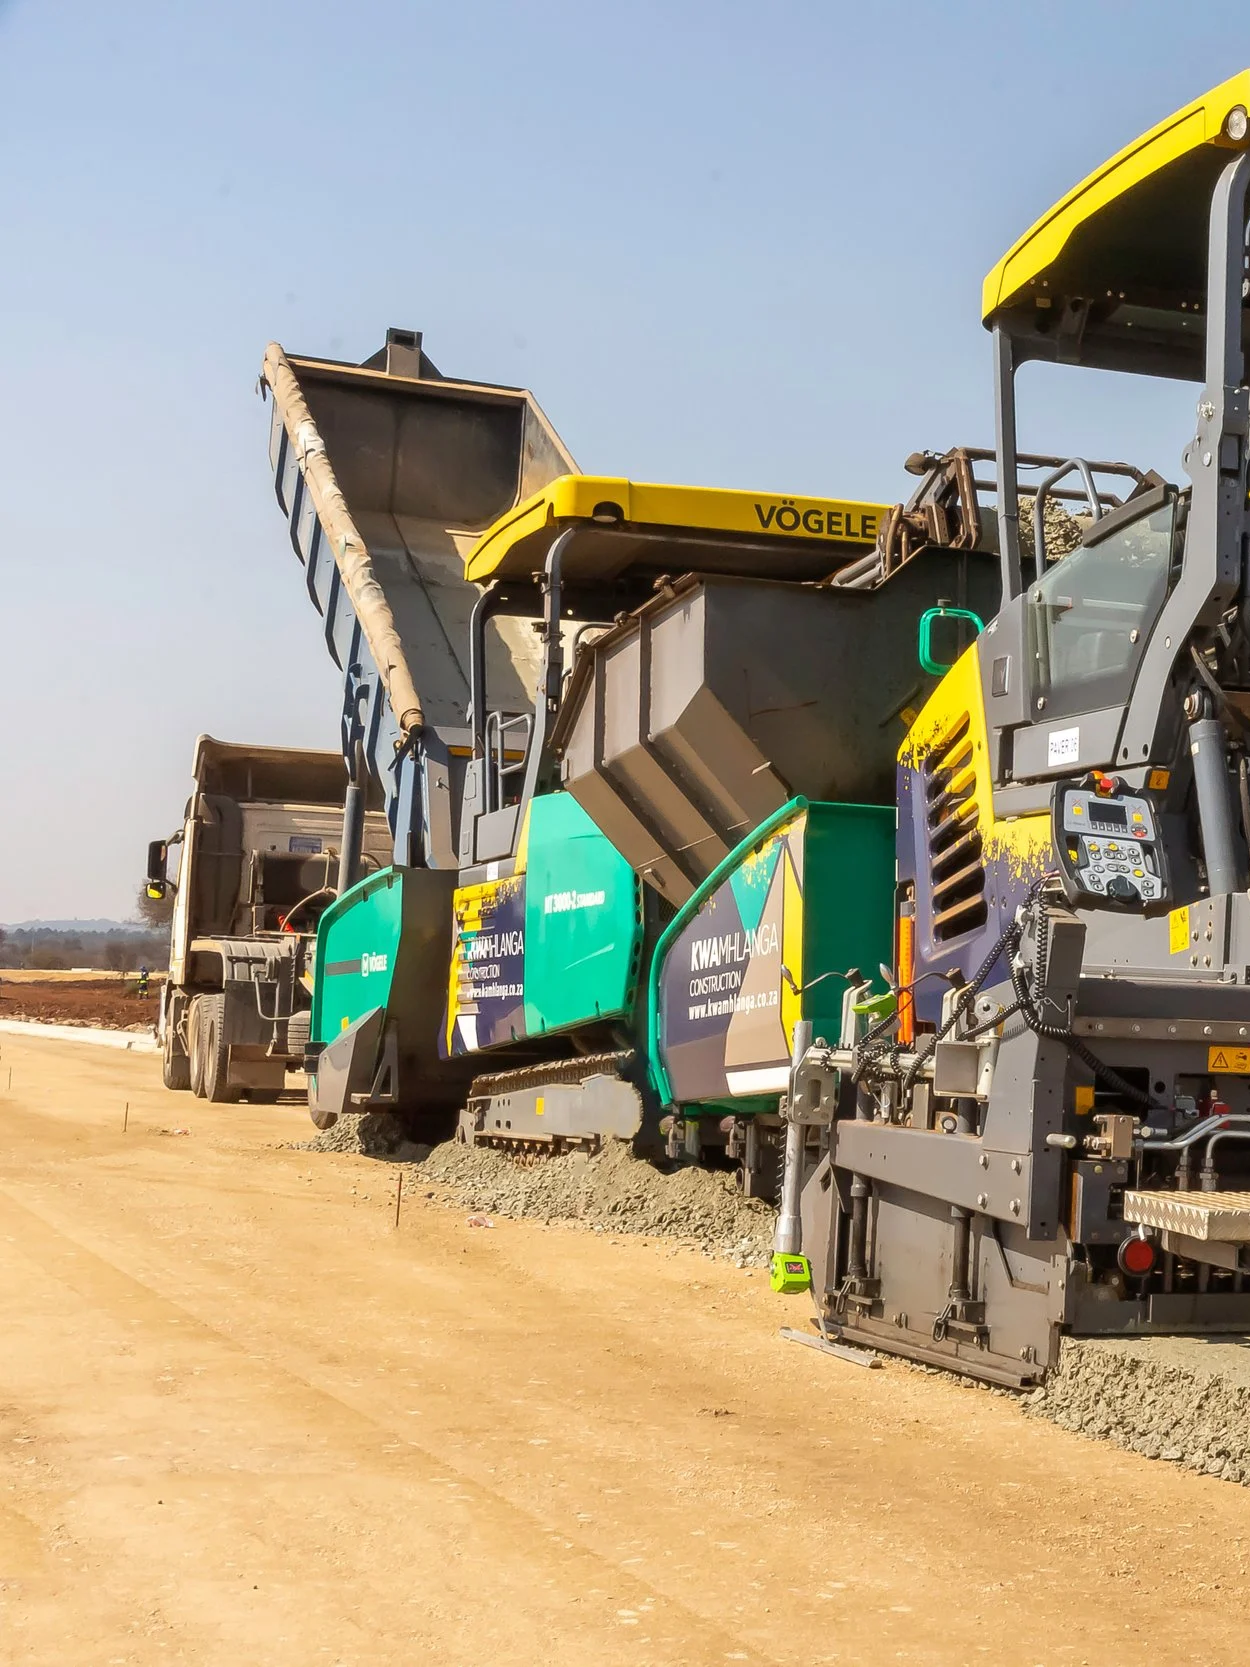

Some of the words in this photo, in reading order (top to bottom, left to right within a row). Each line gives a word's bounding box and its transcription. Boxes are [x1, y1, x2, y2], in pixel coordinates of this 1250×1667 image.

[754, 500, 877, 539] VÖGELE
[690, 922, 779, 972] KWAMHLANGA
[689, 970, 742, 997] CONSTRUCTION
[688, 990, 778, 1020] www.kwamhlanga.co.za
